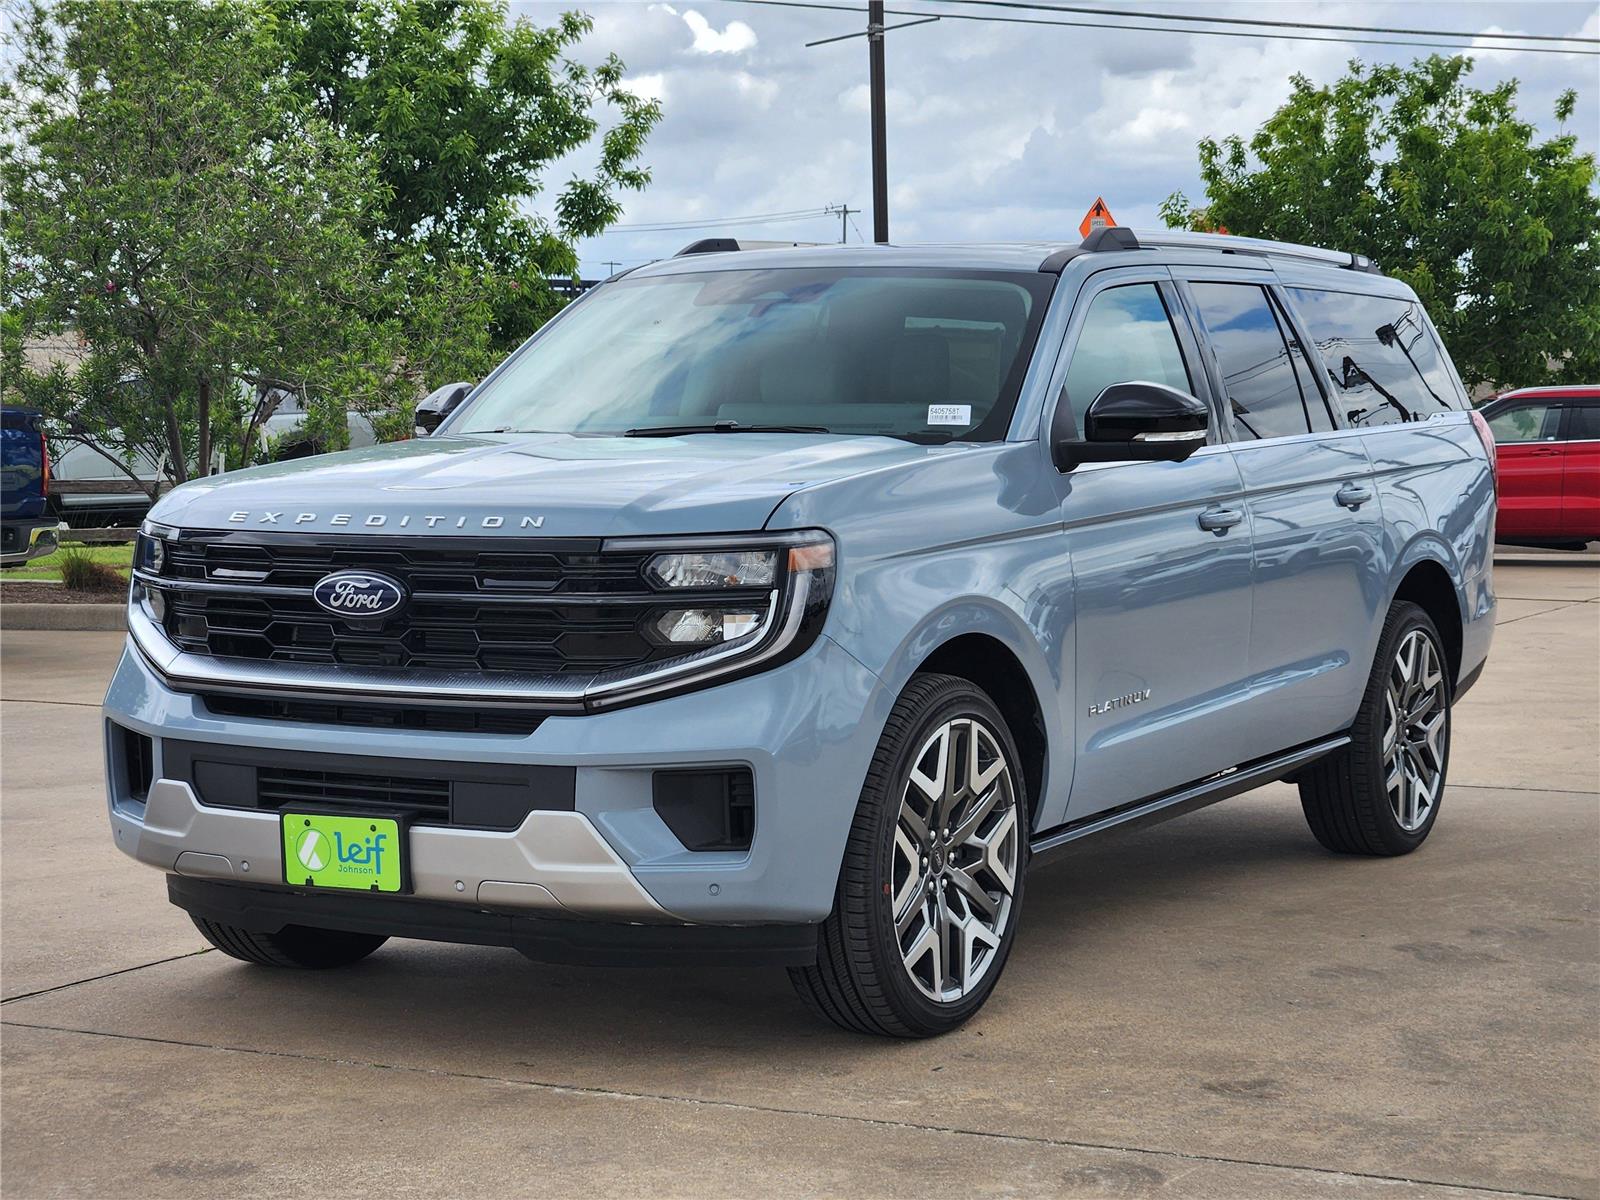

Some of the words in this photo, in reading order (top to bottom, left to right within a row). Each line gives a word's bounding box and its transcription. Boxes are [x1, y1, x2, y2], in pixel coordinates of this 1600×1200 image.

[228, 511, 546, 528] EXPEDITION
[329, 580, 384, 610] Ford
[1087, 688, 1151, 718] PLATINUM
[337, 864, 374, 874] Johnson
